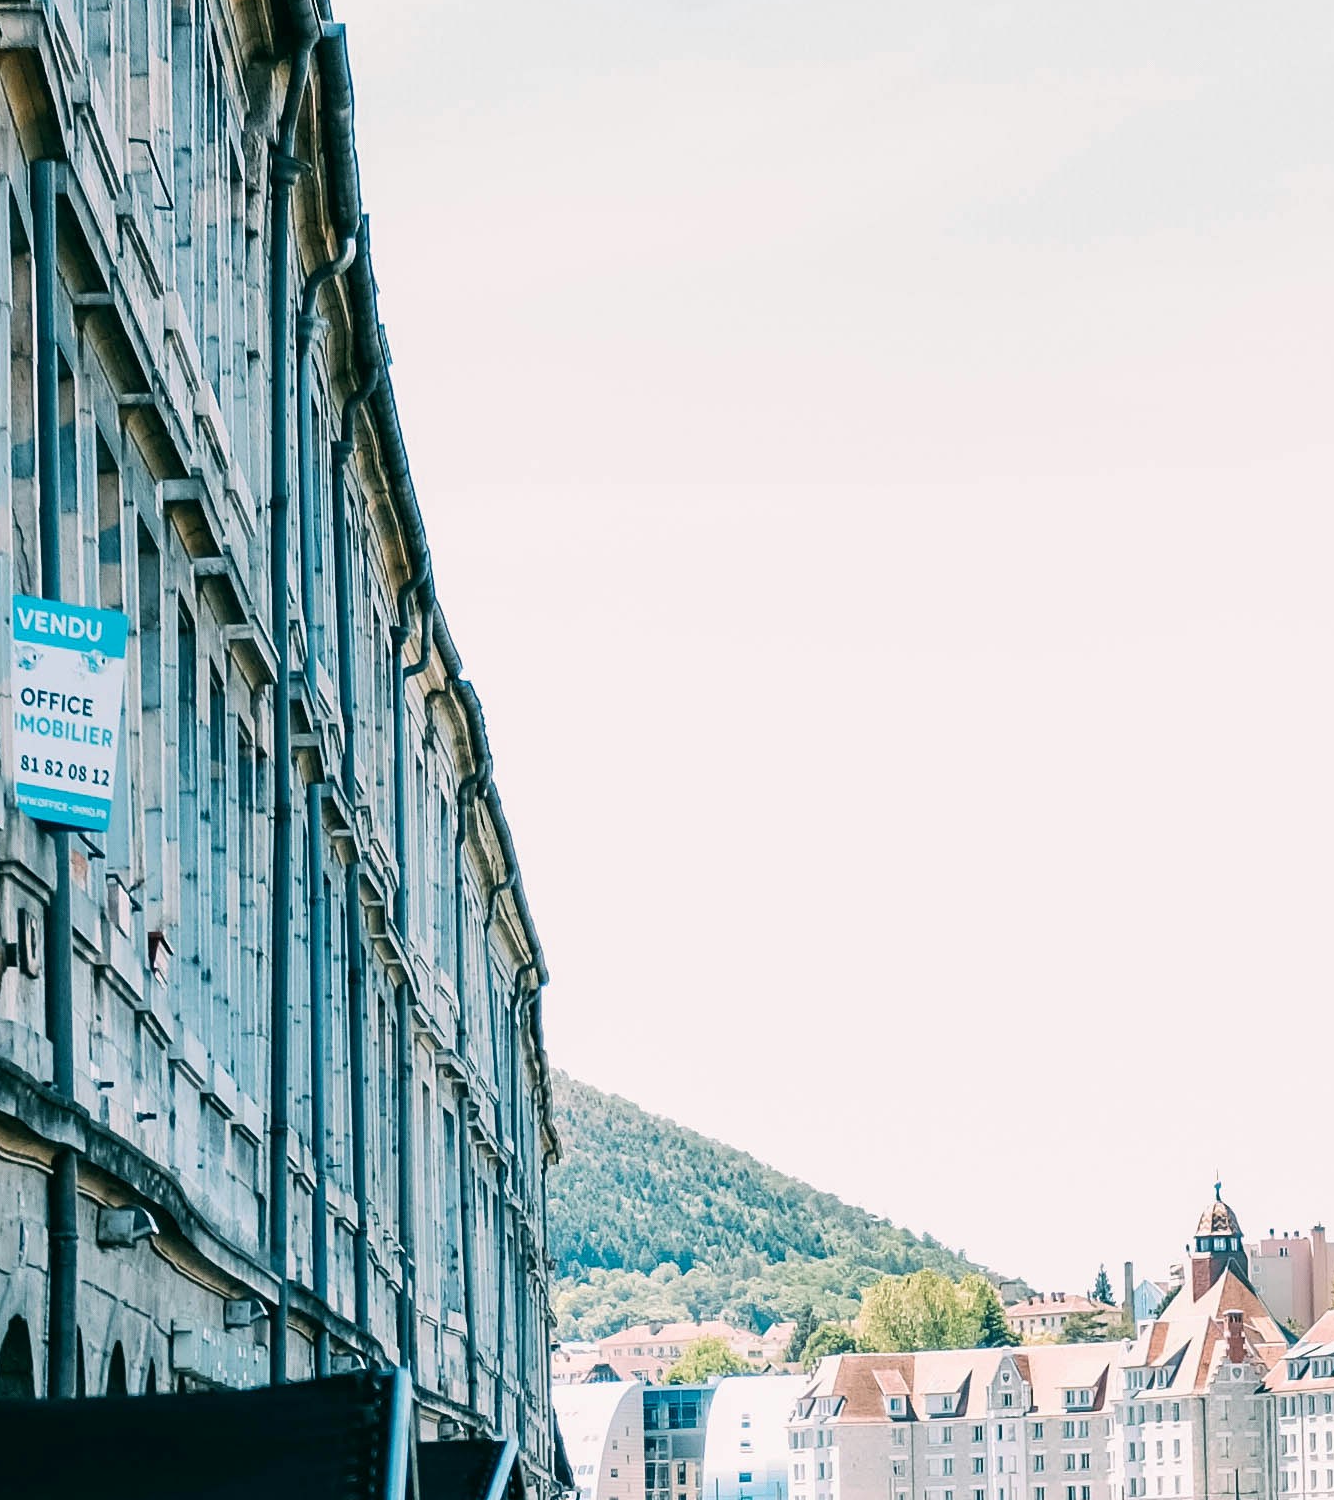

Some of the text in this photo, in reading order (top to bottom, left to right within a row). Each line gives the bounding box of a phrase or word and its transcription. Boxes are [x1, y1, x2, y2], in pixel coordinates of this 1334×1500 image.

[17, 607, 103, 642] VENDU
[21, 687, 94, 717] OFFICE
[20, 754, 39, 773] 81
[44, 759, 63, 778] 82
[91, 768, 110, 787] 12
